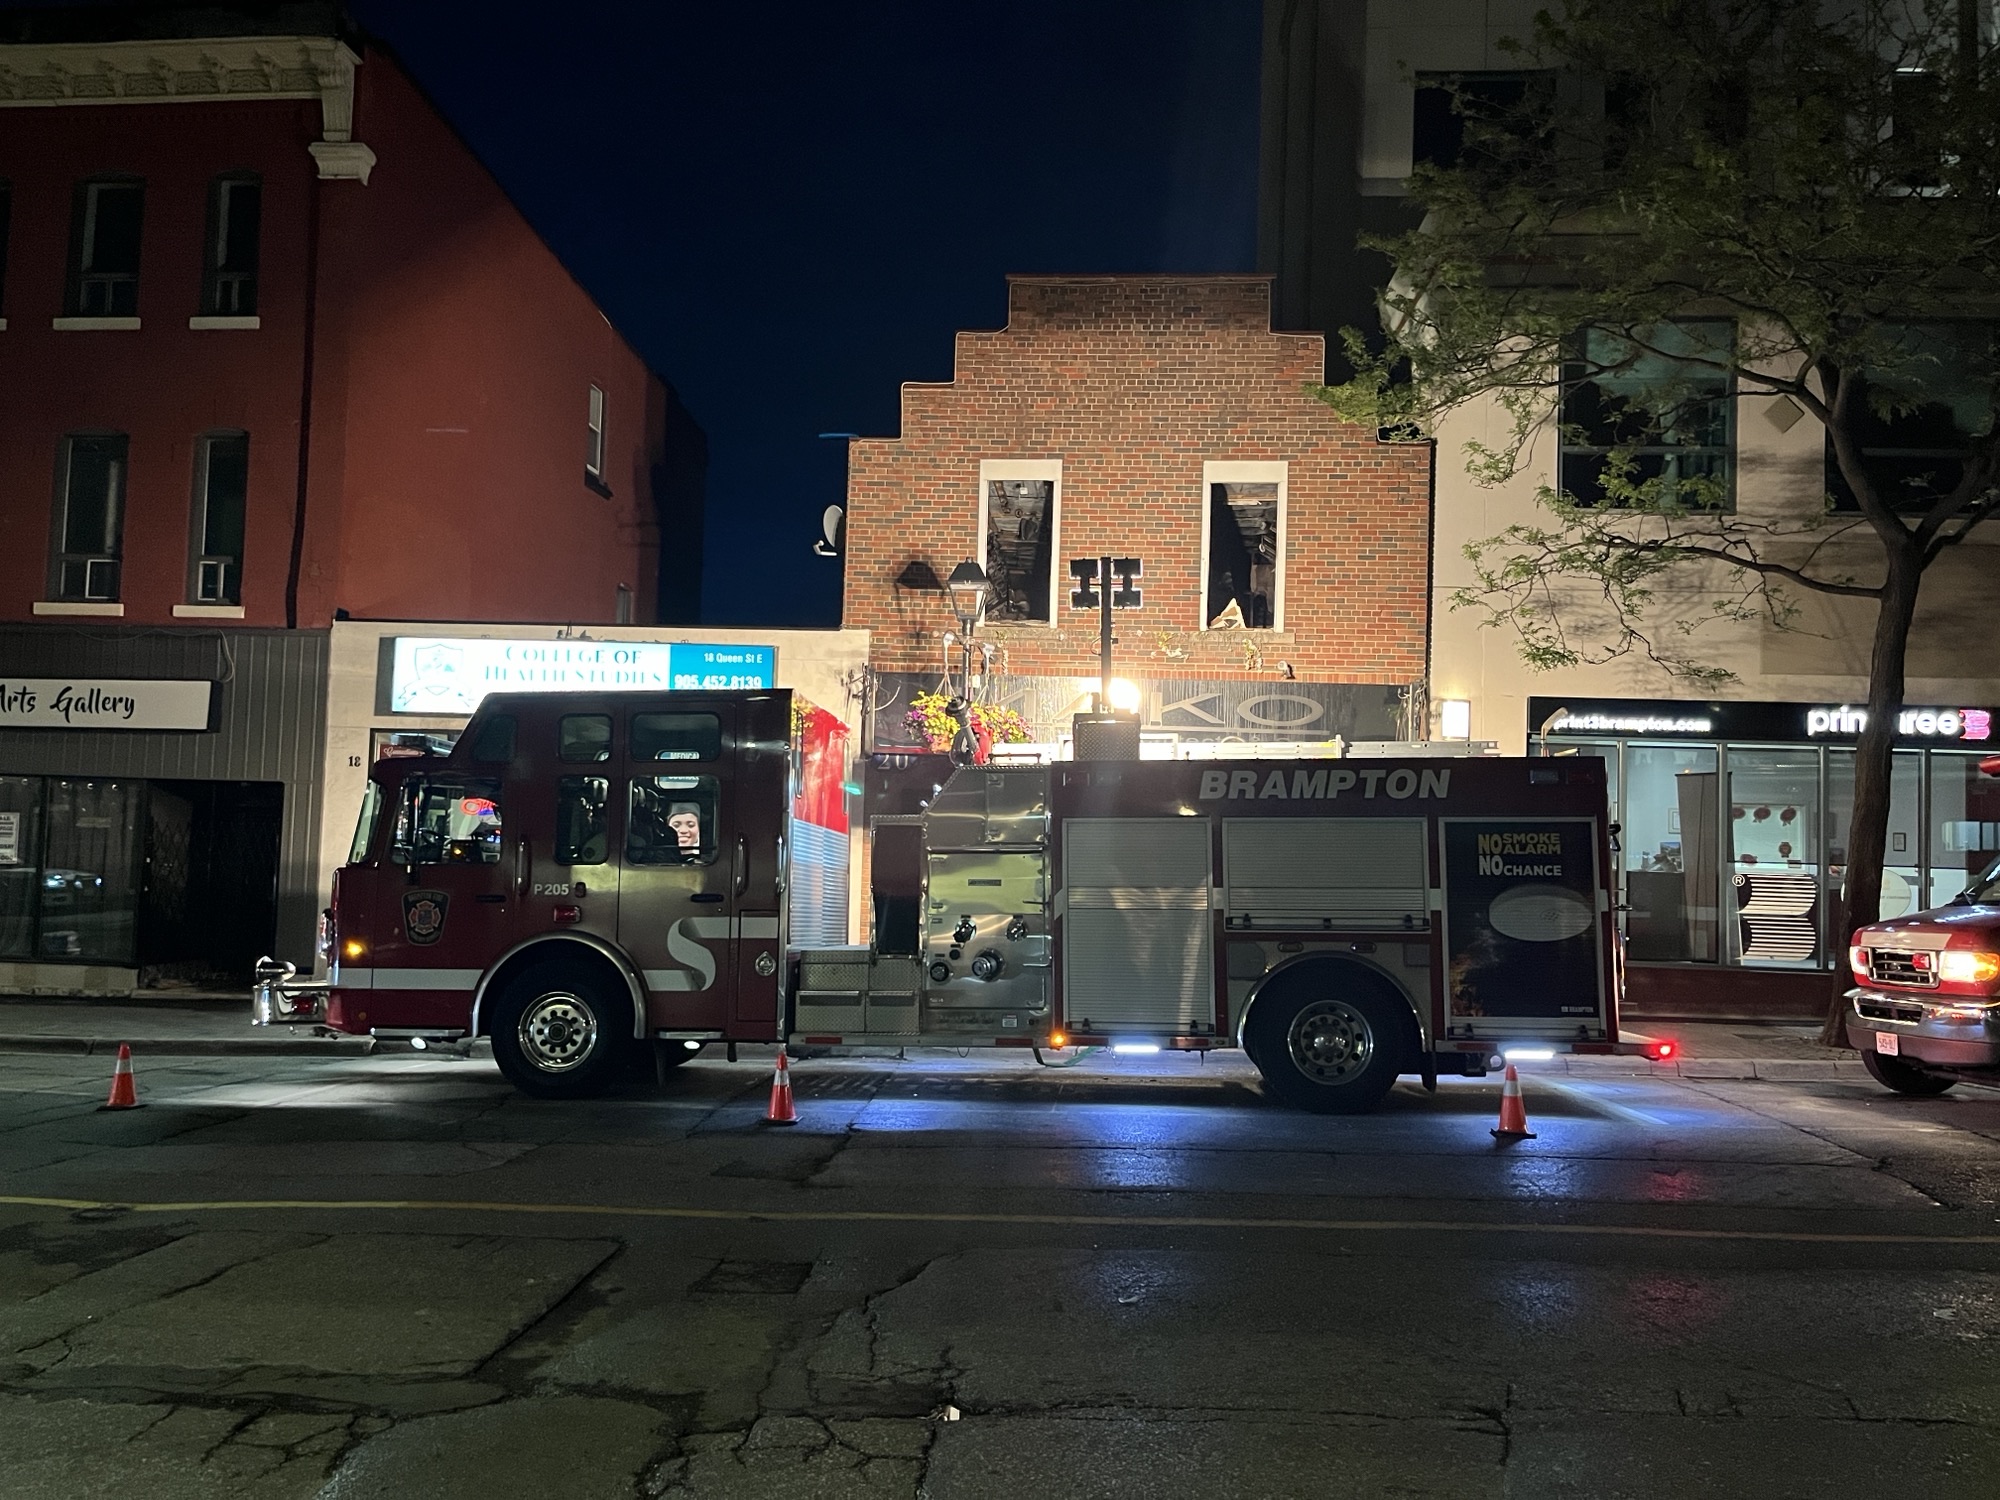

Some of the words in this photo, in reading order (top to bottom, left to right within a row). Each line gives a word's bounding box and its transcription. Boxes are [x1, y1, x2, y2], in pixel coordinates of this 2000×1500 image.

[506, 646, 605, 664] COLLEGE
[614, 650, 641, 664] OF
[704, 652, 714, 663] 18
[716, 653, 743, 664] Queen
[757, 654, 763, 664] E
[49, 686, 135, 723] Gallery
[1553, 714, 1711, 733] print3brampton.com
[348, 756, 361, 767] 18
[1200, 769, 1450, 799] BRAMPTON
[1478, 834, 1502, 854] NO
[1503, 833, 1560, 843] SMOKE
[1503, 844, 1561, 854] ALARM
[1479, 855, 1503, 875] NO
[1504, 865, 1562, 875] CHANCE
[534, 884, 542, 895] P
[544, 884, 569, 895] 205
